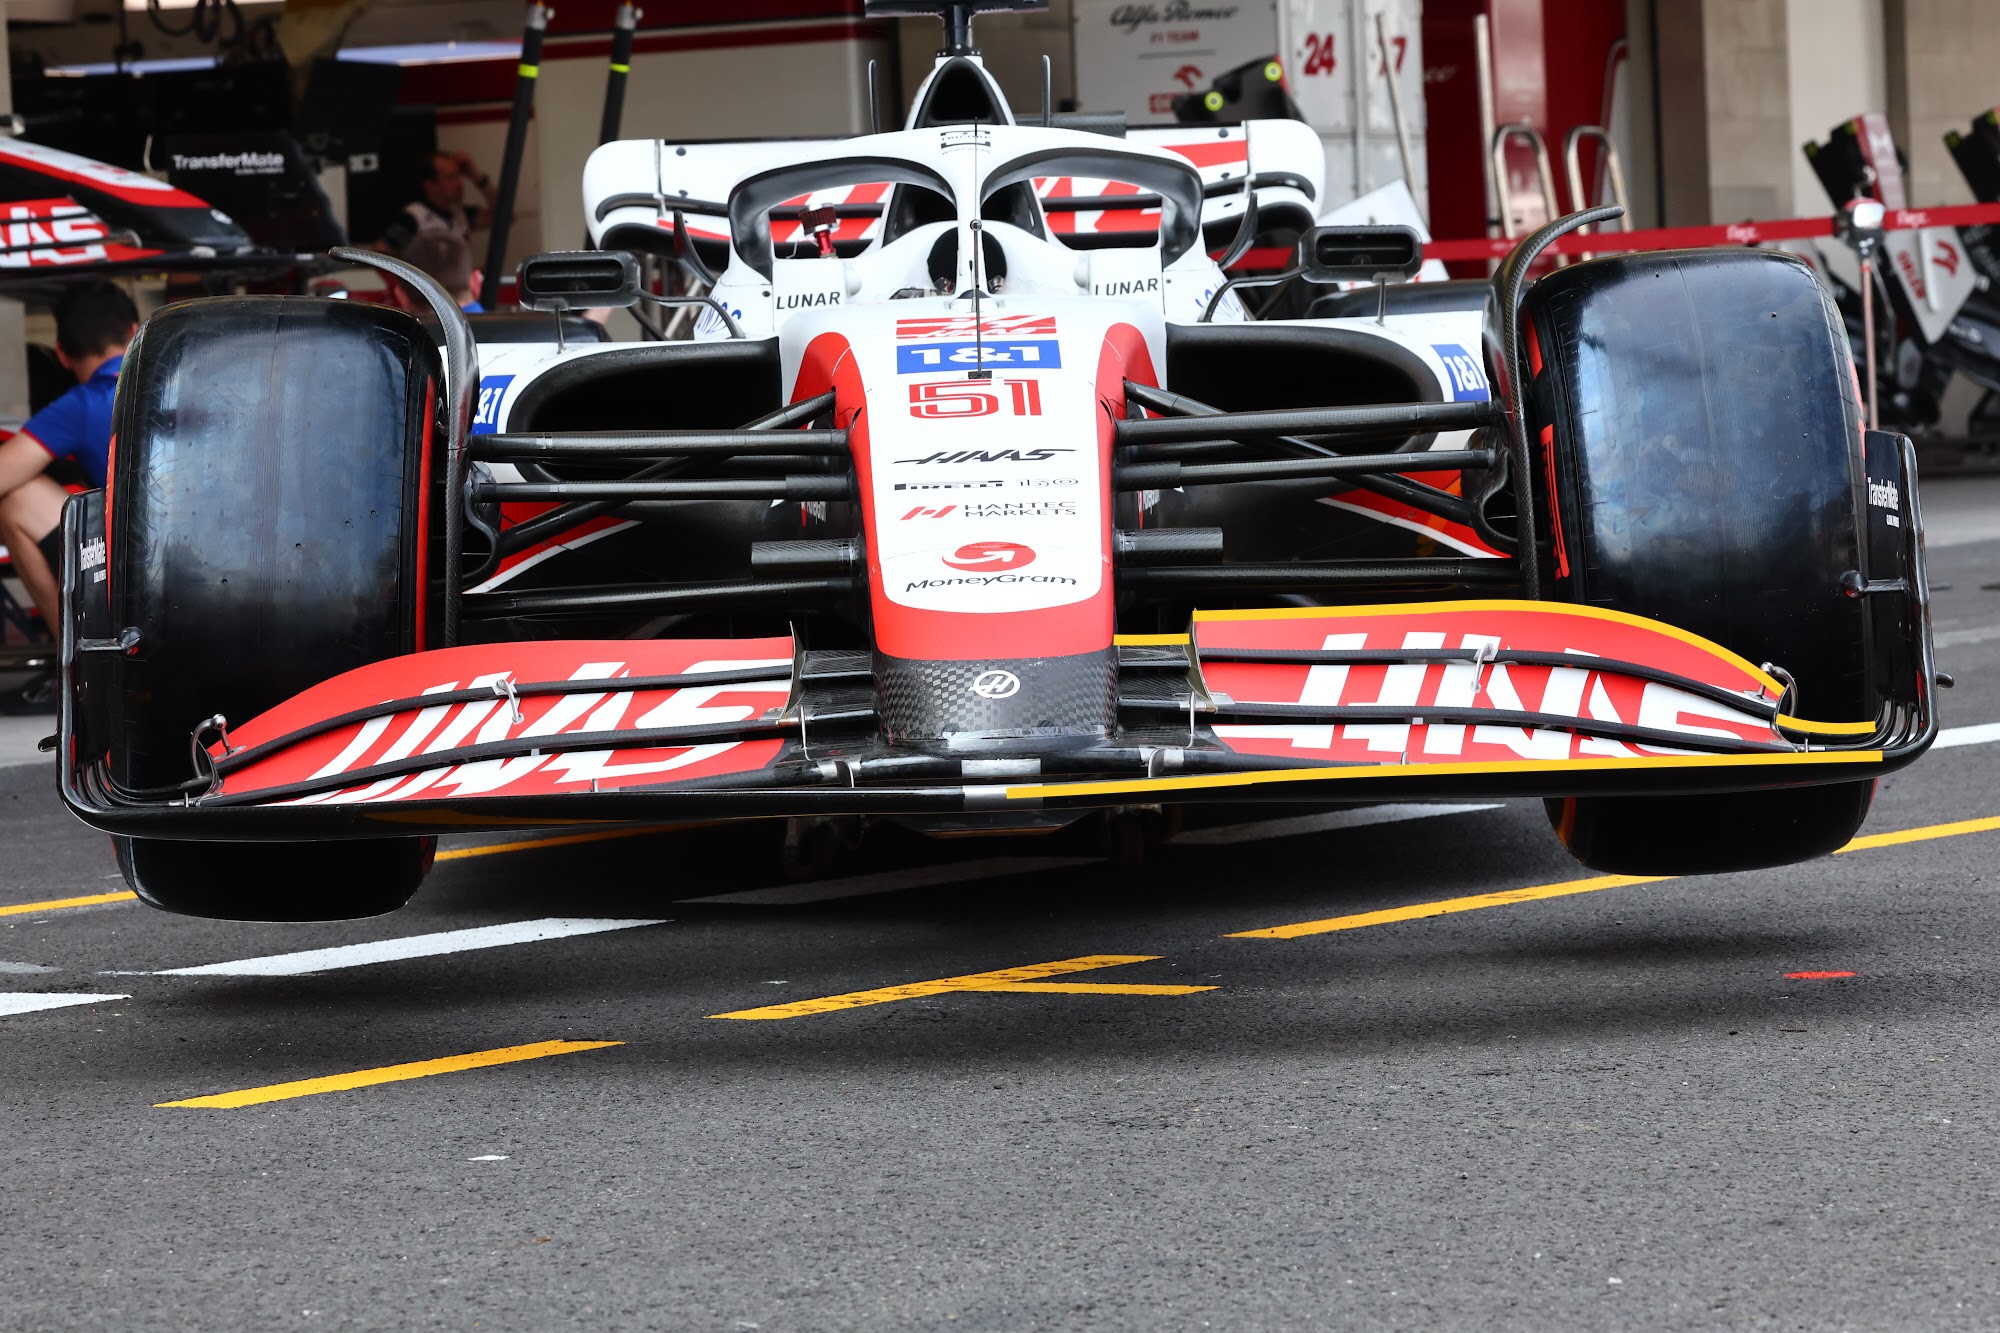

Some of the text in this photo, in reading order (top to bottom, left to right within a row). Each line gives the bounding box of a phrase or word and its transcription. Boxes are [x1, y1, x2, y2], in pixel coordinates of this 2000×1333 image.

[1304, 32, 1336, 77] 24
[172, 151, 285, 170] TransferMate
[1094, 278, 1159, 297] LUNAR
[776, 291, 841, 310] LUNAR
[910, 345, 1041, 365] 1&1
[1442, 355, 1485, 392] 1&1
[473, 387, 504, 425] &1
[909, 379, 1042, 419] 51
[892, 448, 1078, 465] HAAS
[964, 501, 1077, 511] HANTEC
[964, 509, 1077, 518] MARKETS
[905, 574, 1077, 593] MoneyGram
